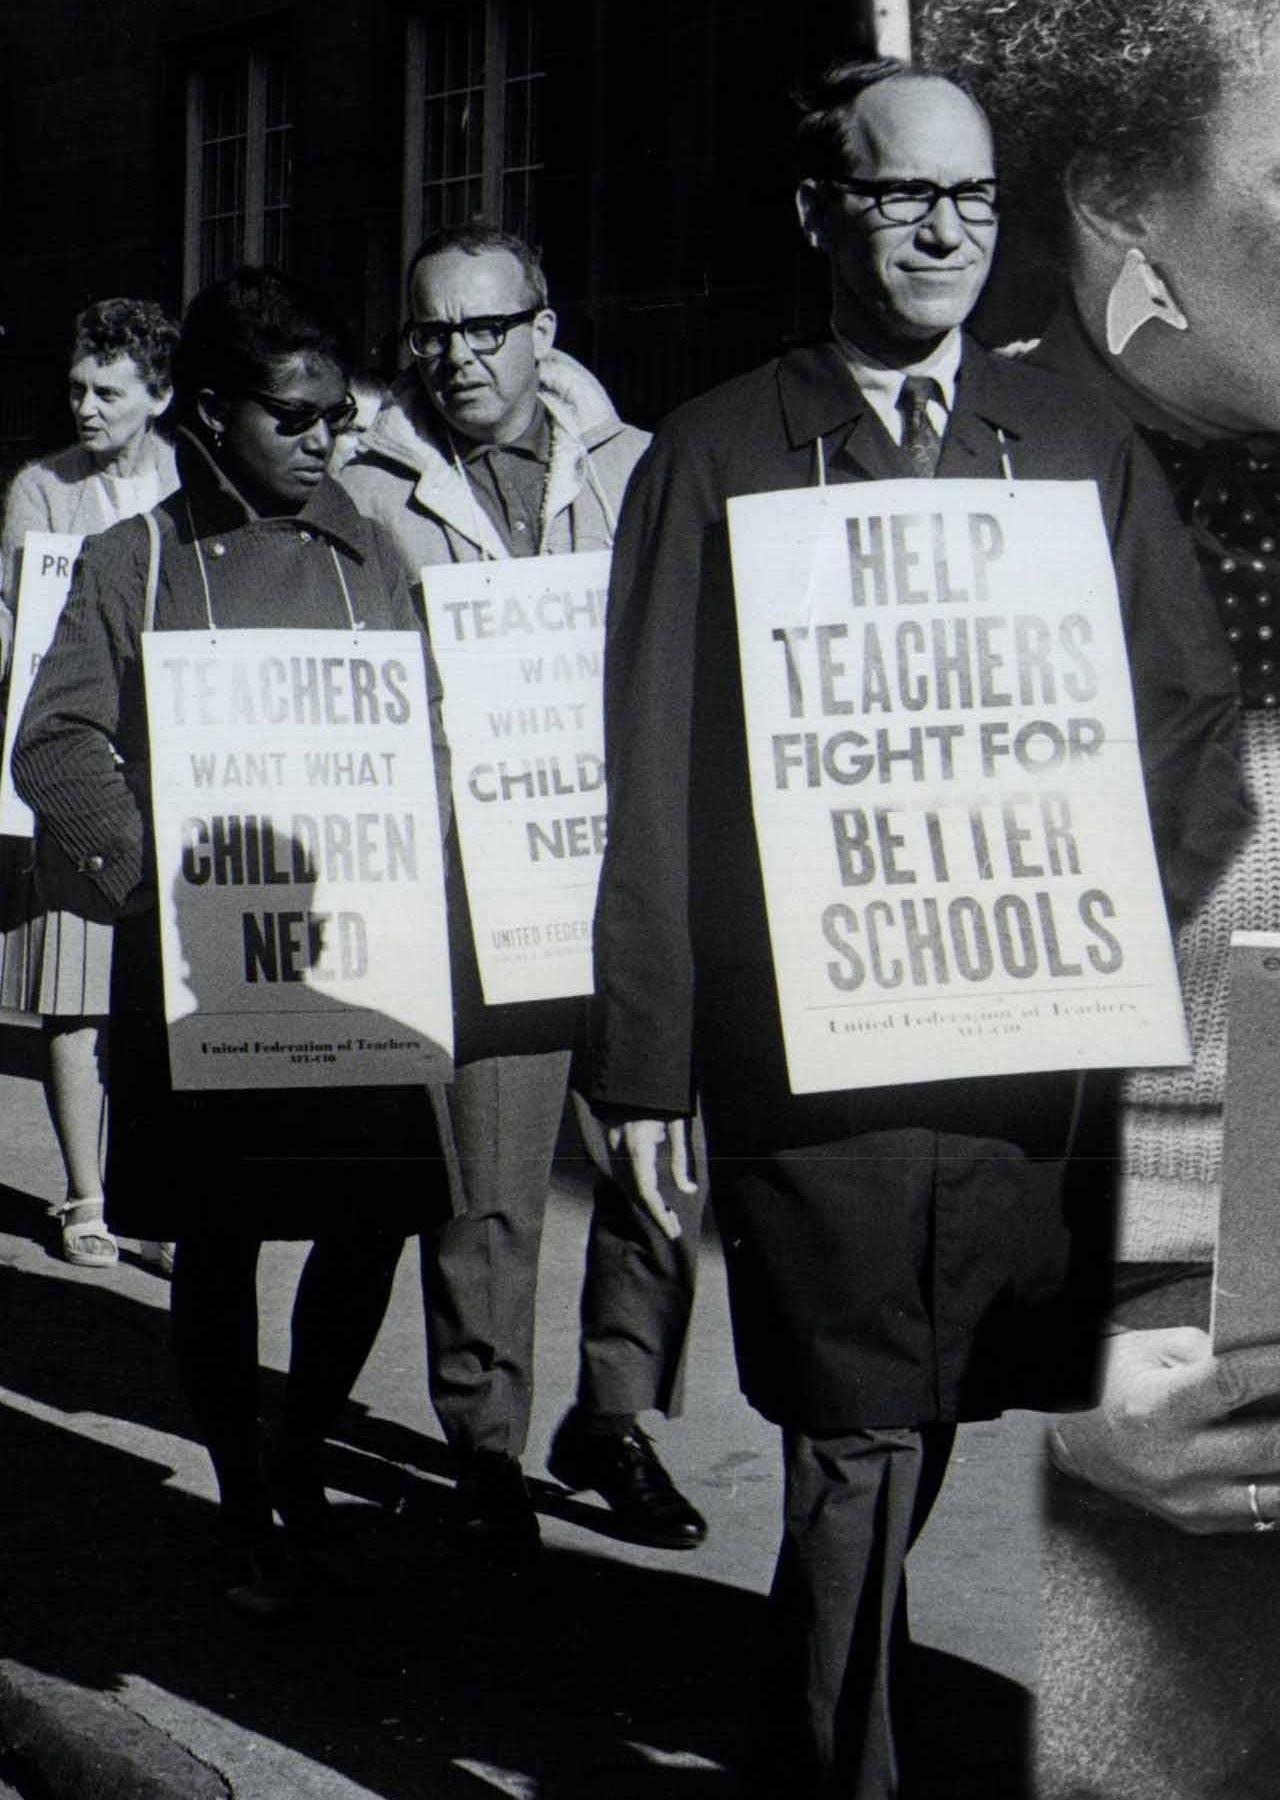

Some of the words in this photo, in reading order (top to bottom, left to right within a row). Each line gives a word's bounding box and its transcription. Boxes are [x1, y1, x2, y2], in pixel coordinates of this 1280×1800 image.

[845, 512, 1005, 607] HELP
[162, 657, 410, 725] TEACHERS
[772, 613, 1099, 718] TEACHERS
[487, 703, 585, 738] WHAT
[771, 725, 965, 790] FIGHT
[980, 718, 1106, 778] FOR
[191, 752, 287, 789] WANT
[306, 752, 396, 787] WHAT
[181, 813, 419, 887] CHILDREN
[830, 790, 1082, 887] BETTER
[242, 911, 368, 984] NEED
[820, 889, 1124, 992] SCHOOLS
[202, 1042, 248, 1055] United
[254, 1040, 333, 1054] Federation
[337, 1039, 353, 1051] of
[356, 1038, 422, 1050] Teachers
